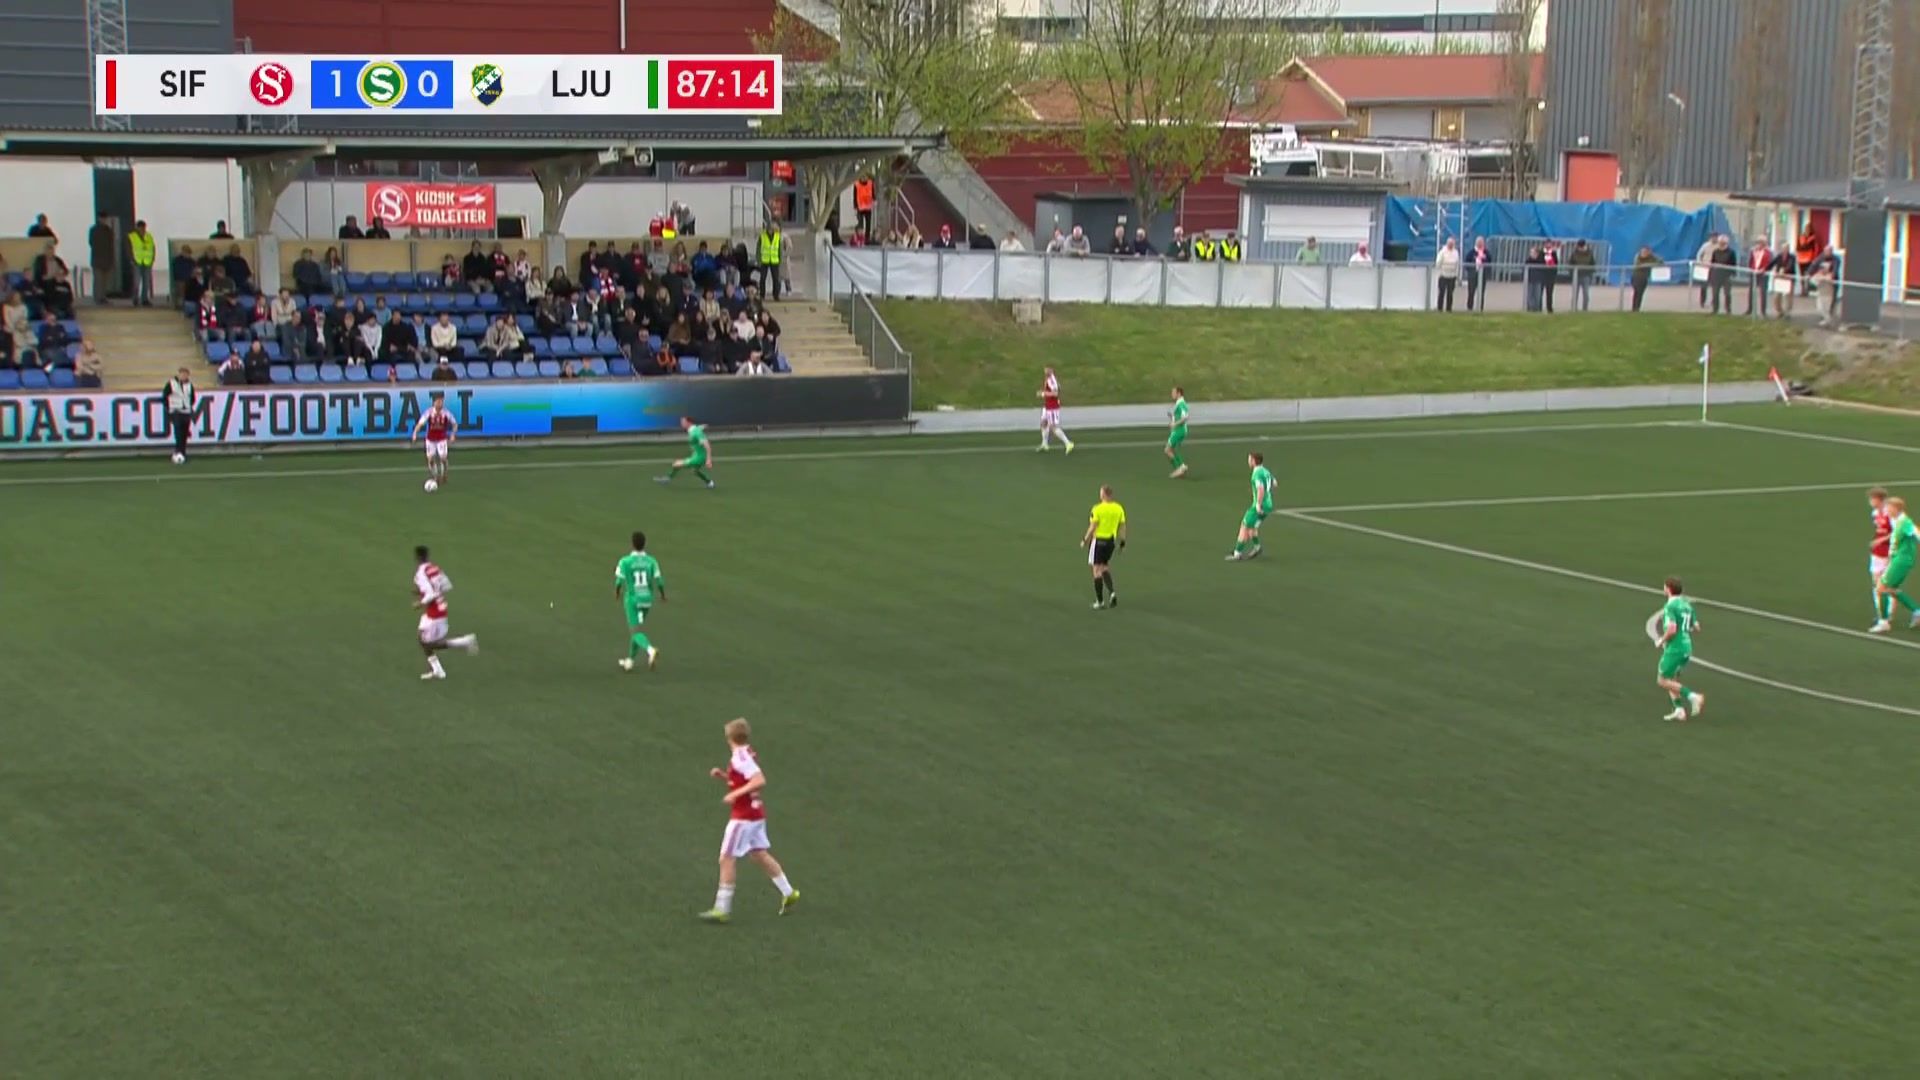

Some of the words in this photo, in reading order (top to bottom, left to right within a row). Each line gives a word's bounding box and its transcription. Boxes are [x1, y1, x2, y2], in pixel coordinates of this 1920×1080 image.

[415, 190, 455, 206] KIOSK
[416, 208, 487, 224] TOALETTER
[633, 570, 648, 586] 11
